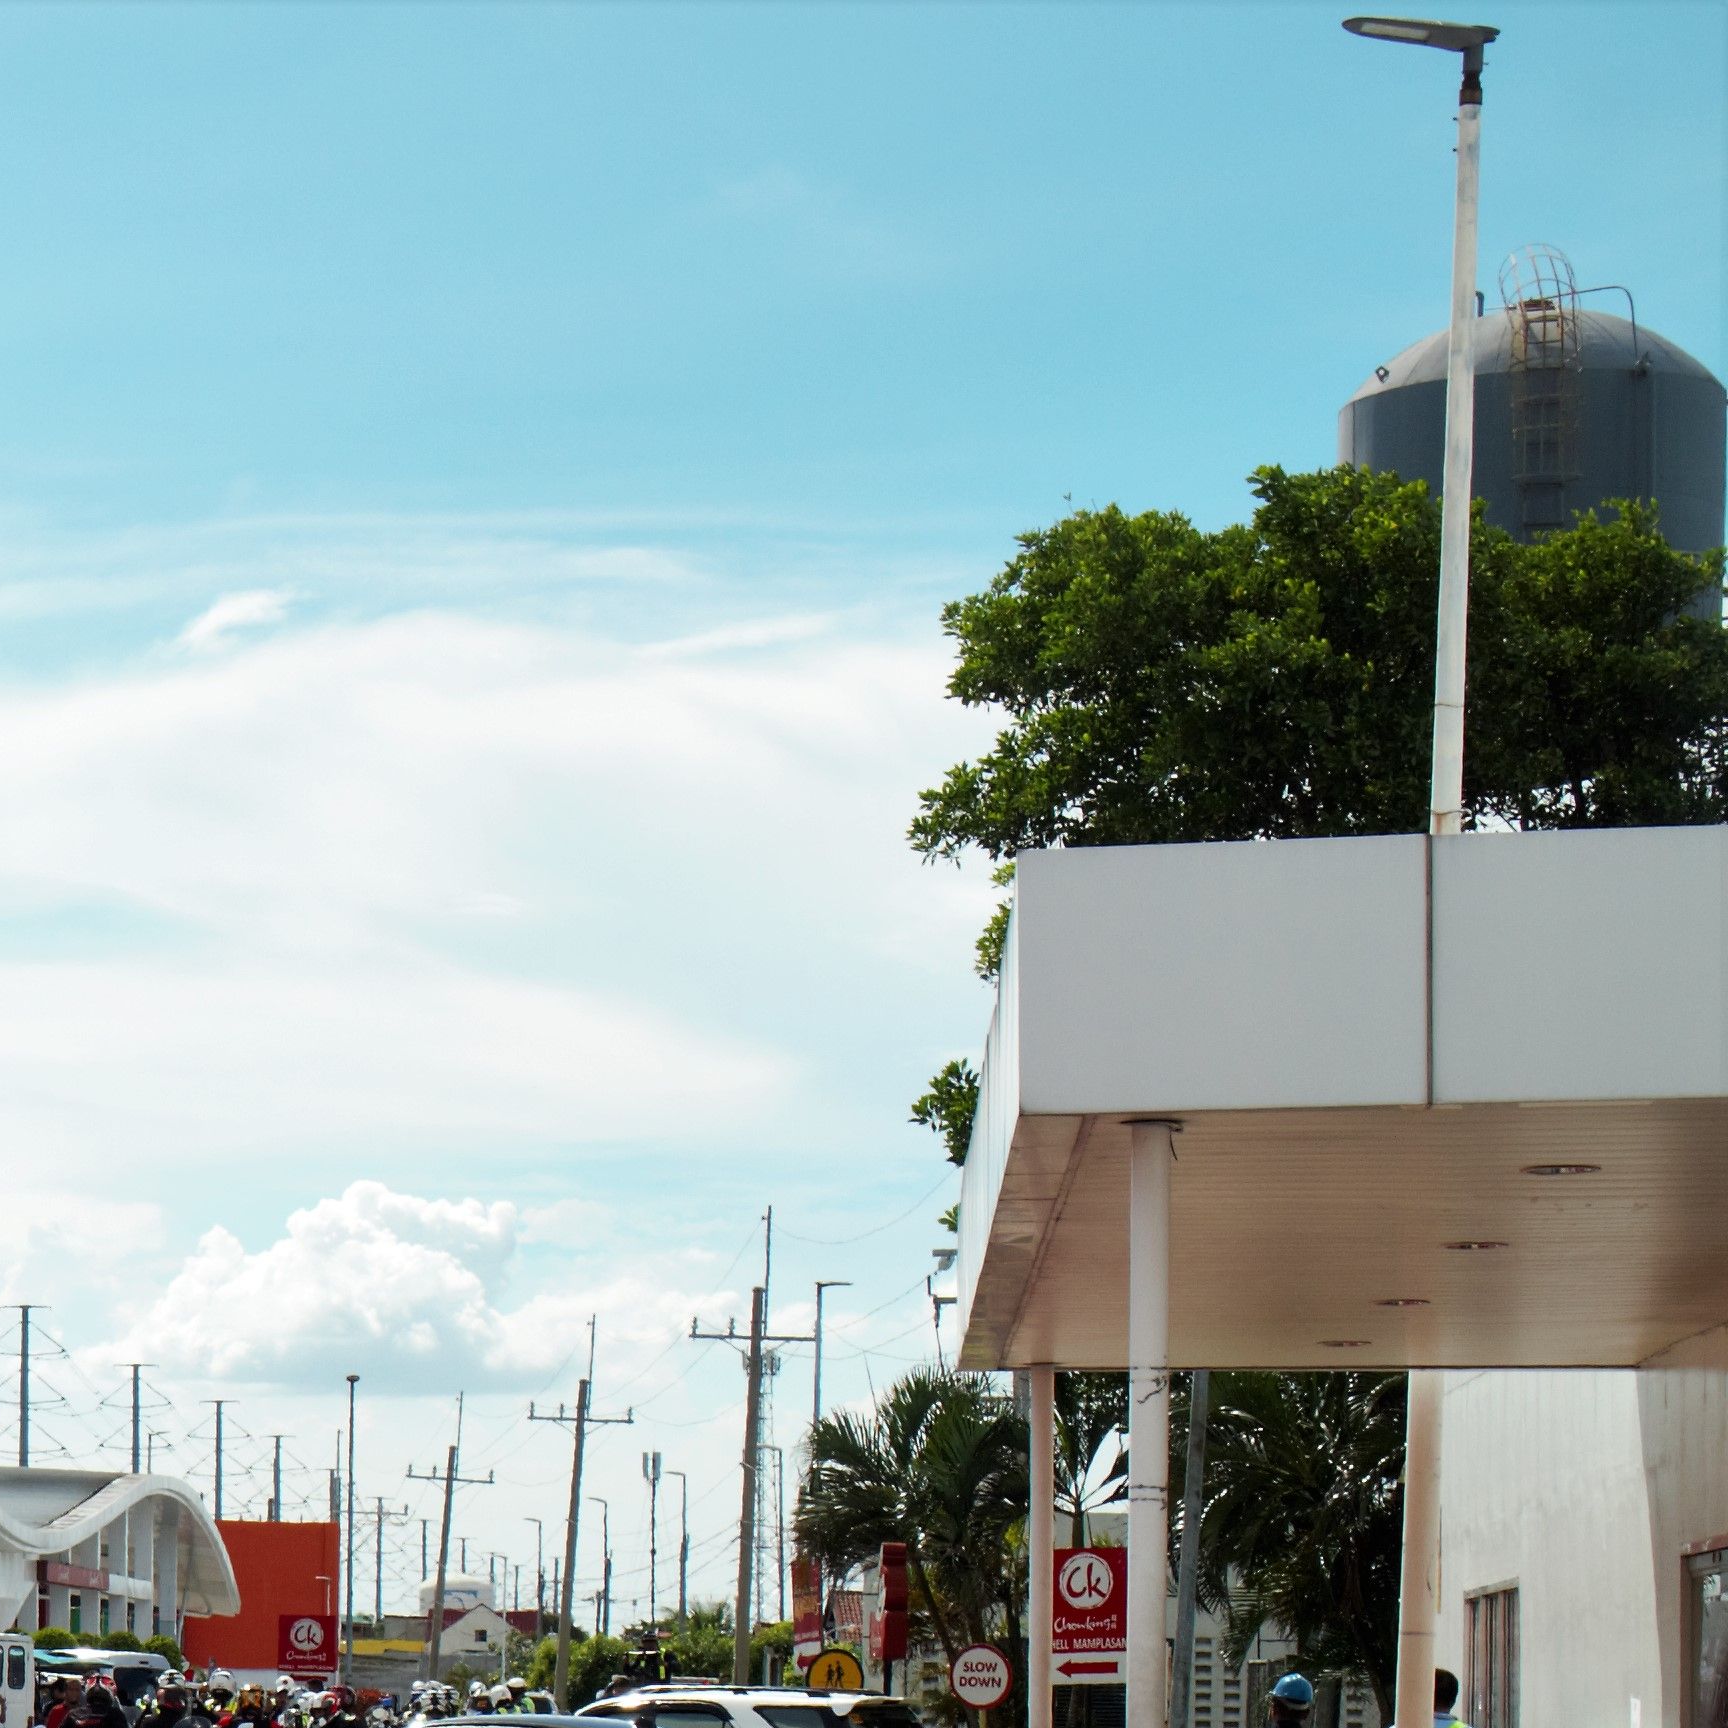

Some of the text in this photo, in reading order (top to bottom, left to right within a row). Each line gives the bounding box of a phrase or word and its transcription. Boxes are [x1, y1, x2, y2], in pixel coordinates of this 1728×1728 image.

[1052, 1639, 1070, 1650] HELL
[961, 1661, 998, 1673] SLOW
[958, 1676, 1002, 1688] DOWN
